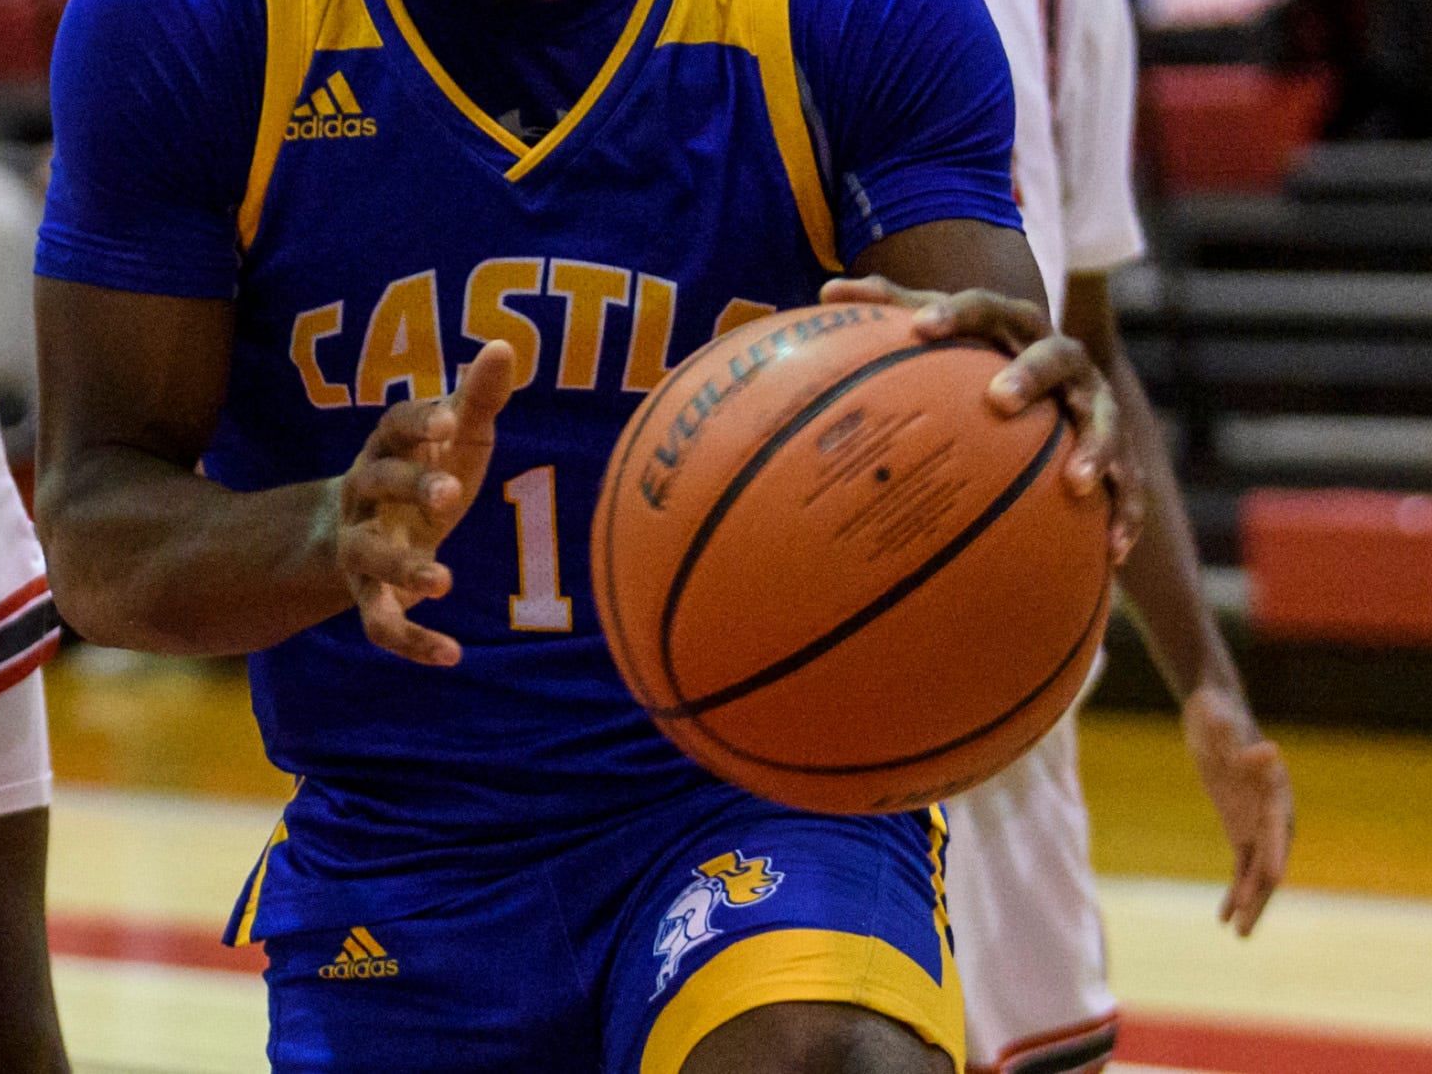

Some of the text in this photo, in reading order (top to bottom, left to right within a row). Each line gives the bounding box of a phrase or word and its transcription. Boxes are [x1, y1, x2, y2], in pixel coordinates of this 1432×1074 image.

[284, 114, 377, 141] adidas
[503, 464, 573, 633] 1
[318, 958, 400, 980] adidas
